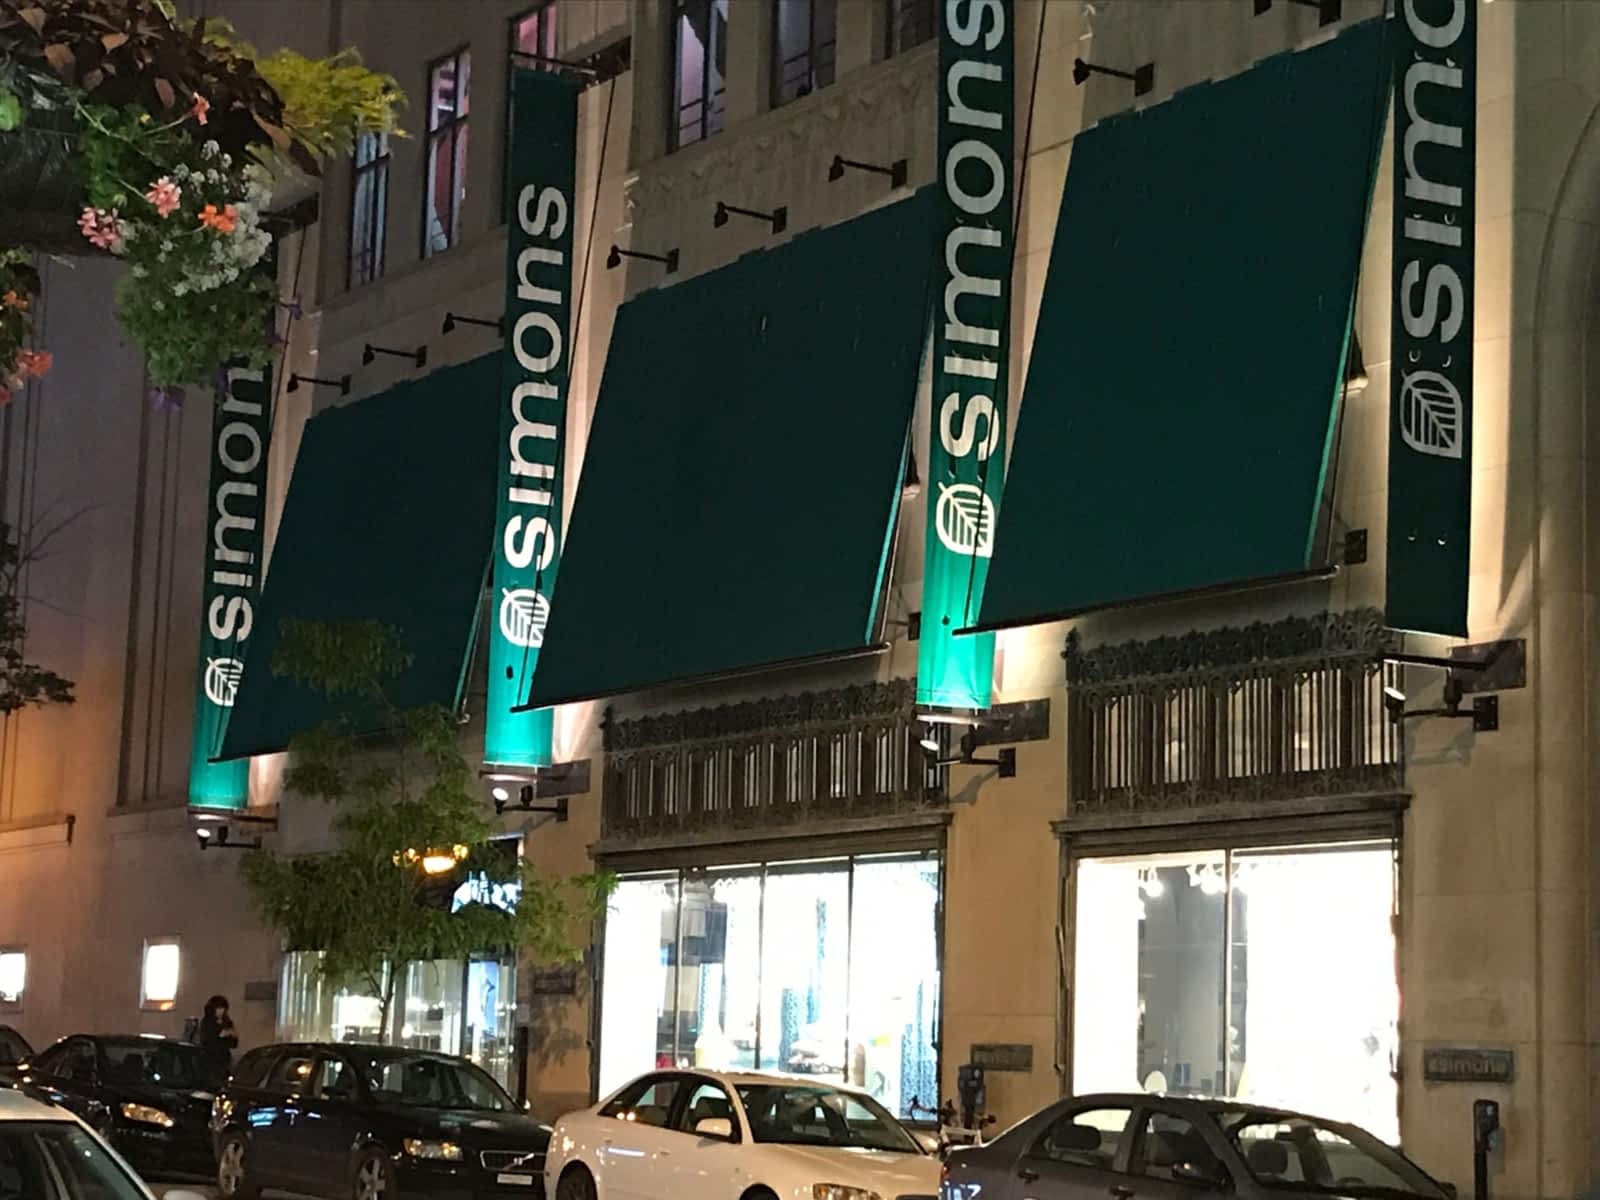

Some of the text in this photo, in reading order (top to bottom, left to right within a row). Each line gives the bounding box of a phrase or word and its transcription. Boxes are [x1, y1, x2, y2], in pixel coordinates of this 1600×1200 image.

[504, 183, 568, 571] simons
[939, 0, 1004, 461] simons
[207, 367, 265, 643] simon
